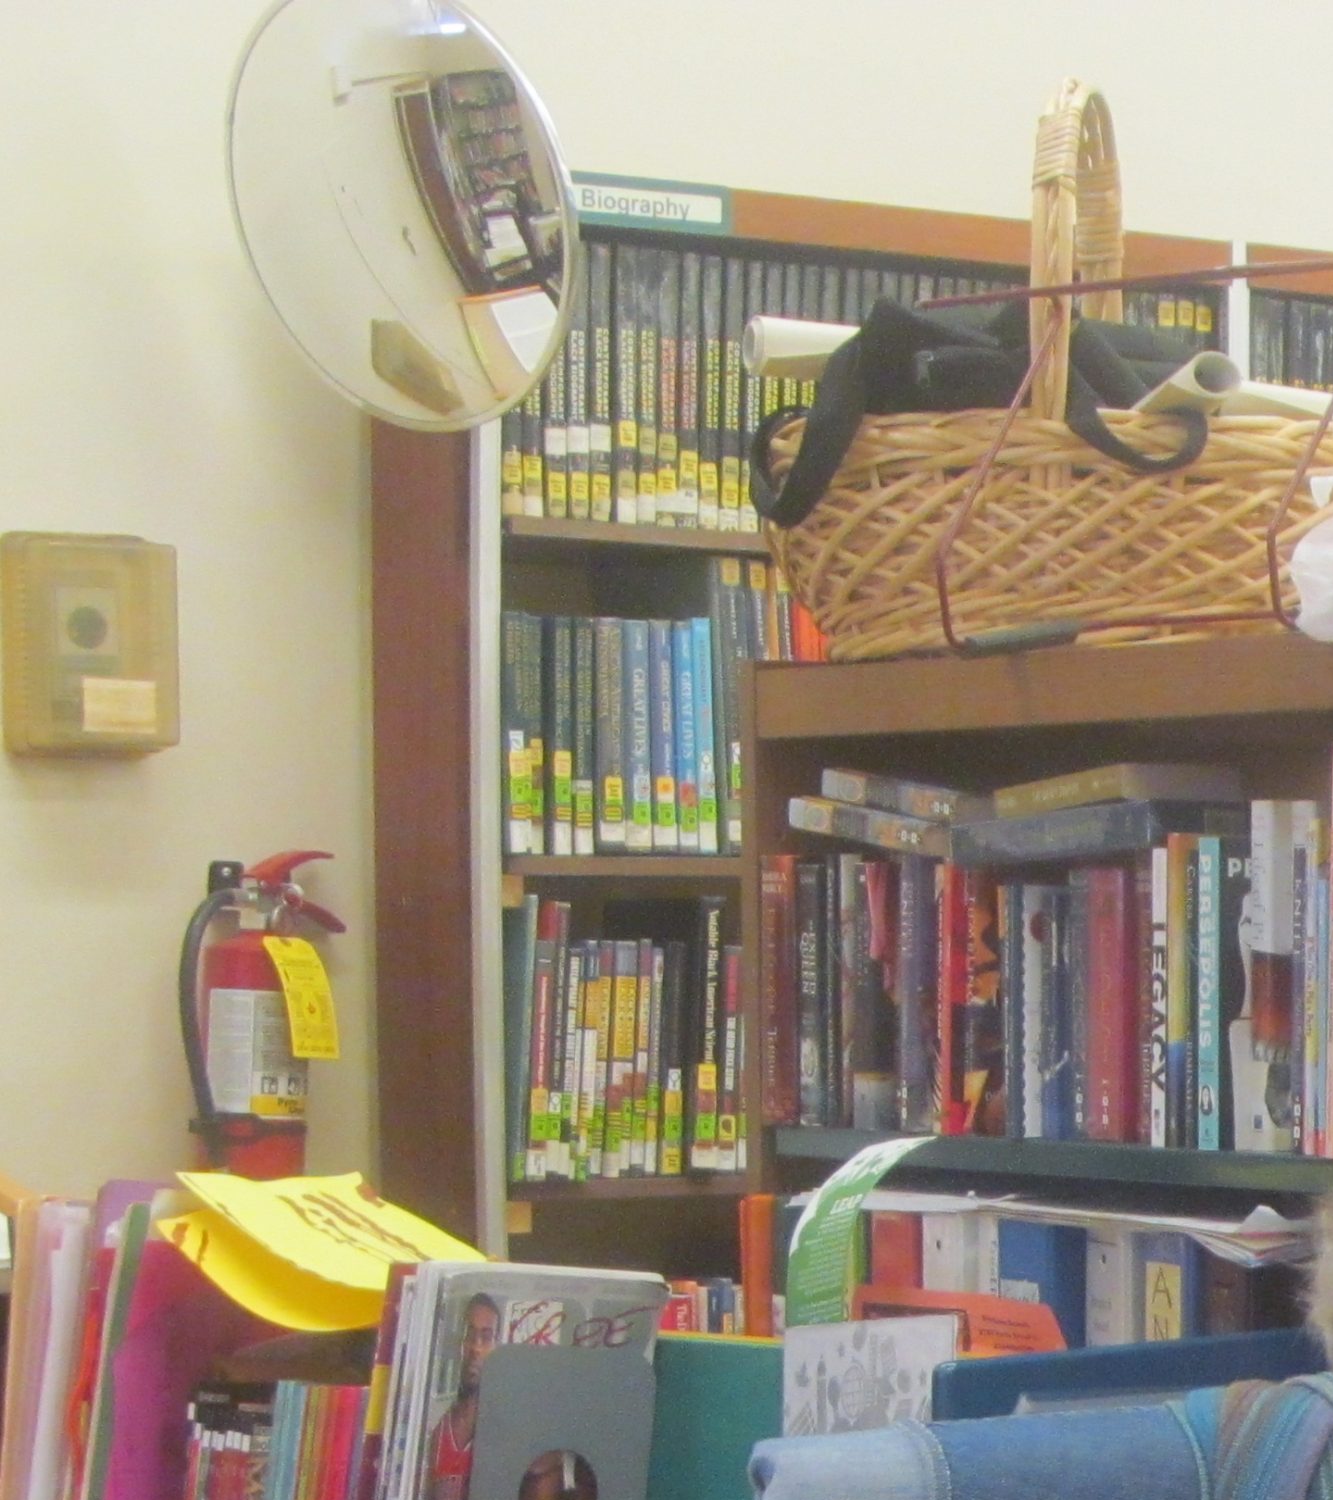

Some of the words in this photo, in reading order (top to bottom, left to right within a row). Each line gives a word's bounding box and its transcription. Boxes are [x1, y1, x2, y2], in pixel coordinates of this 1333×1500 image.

[581, 188, 690, 220] Biography
[633, 668, 645, 714] GREAT
[661, 661, 670, 697] GREAT
[681, 671, 692, 713] GREAT
[632, 717, 645, 758] LIVES
[682, 720, 694, 759] LIVES
[708, 910, 720, 948] Notable
[708, 950, 718, 977] Black
[801, 931, 810, 994] QUEEN
[1199, 854, 1213, 1048] PERSEPOLIS
[706, 982, 717, 1028] American
[1151, 922, 1166, 1094] LEGACY
[1151, 1268, 1173, 1309] A
